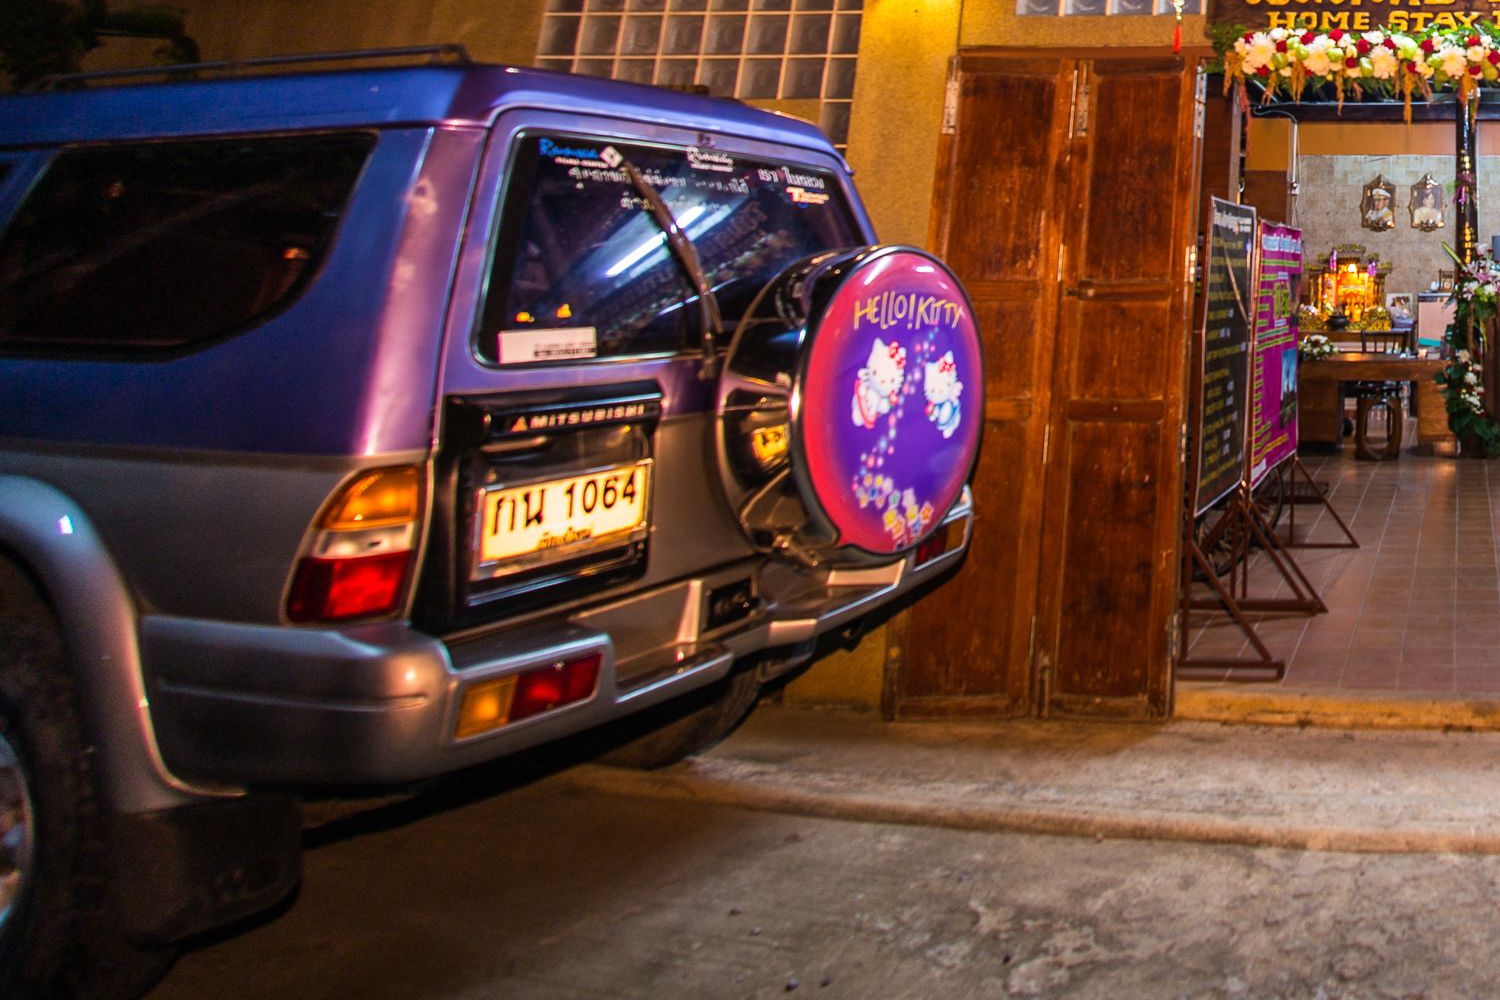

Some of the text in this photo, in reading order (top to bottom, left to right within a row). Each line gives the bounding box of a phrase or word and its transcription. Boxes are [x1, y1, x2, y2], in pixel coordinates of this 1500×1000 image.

[1266, 11, 1370, 31] HOME
[1388, 10, 1480, 32] STAY
[530, 403, 645, 429] MITSUBISHI
[566, 471, 636, 519] 1064
